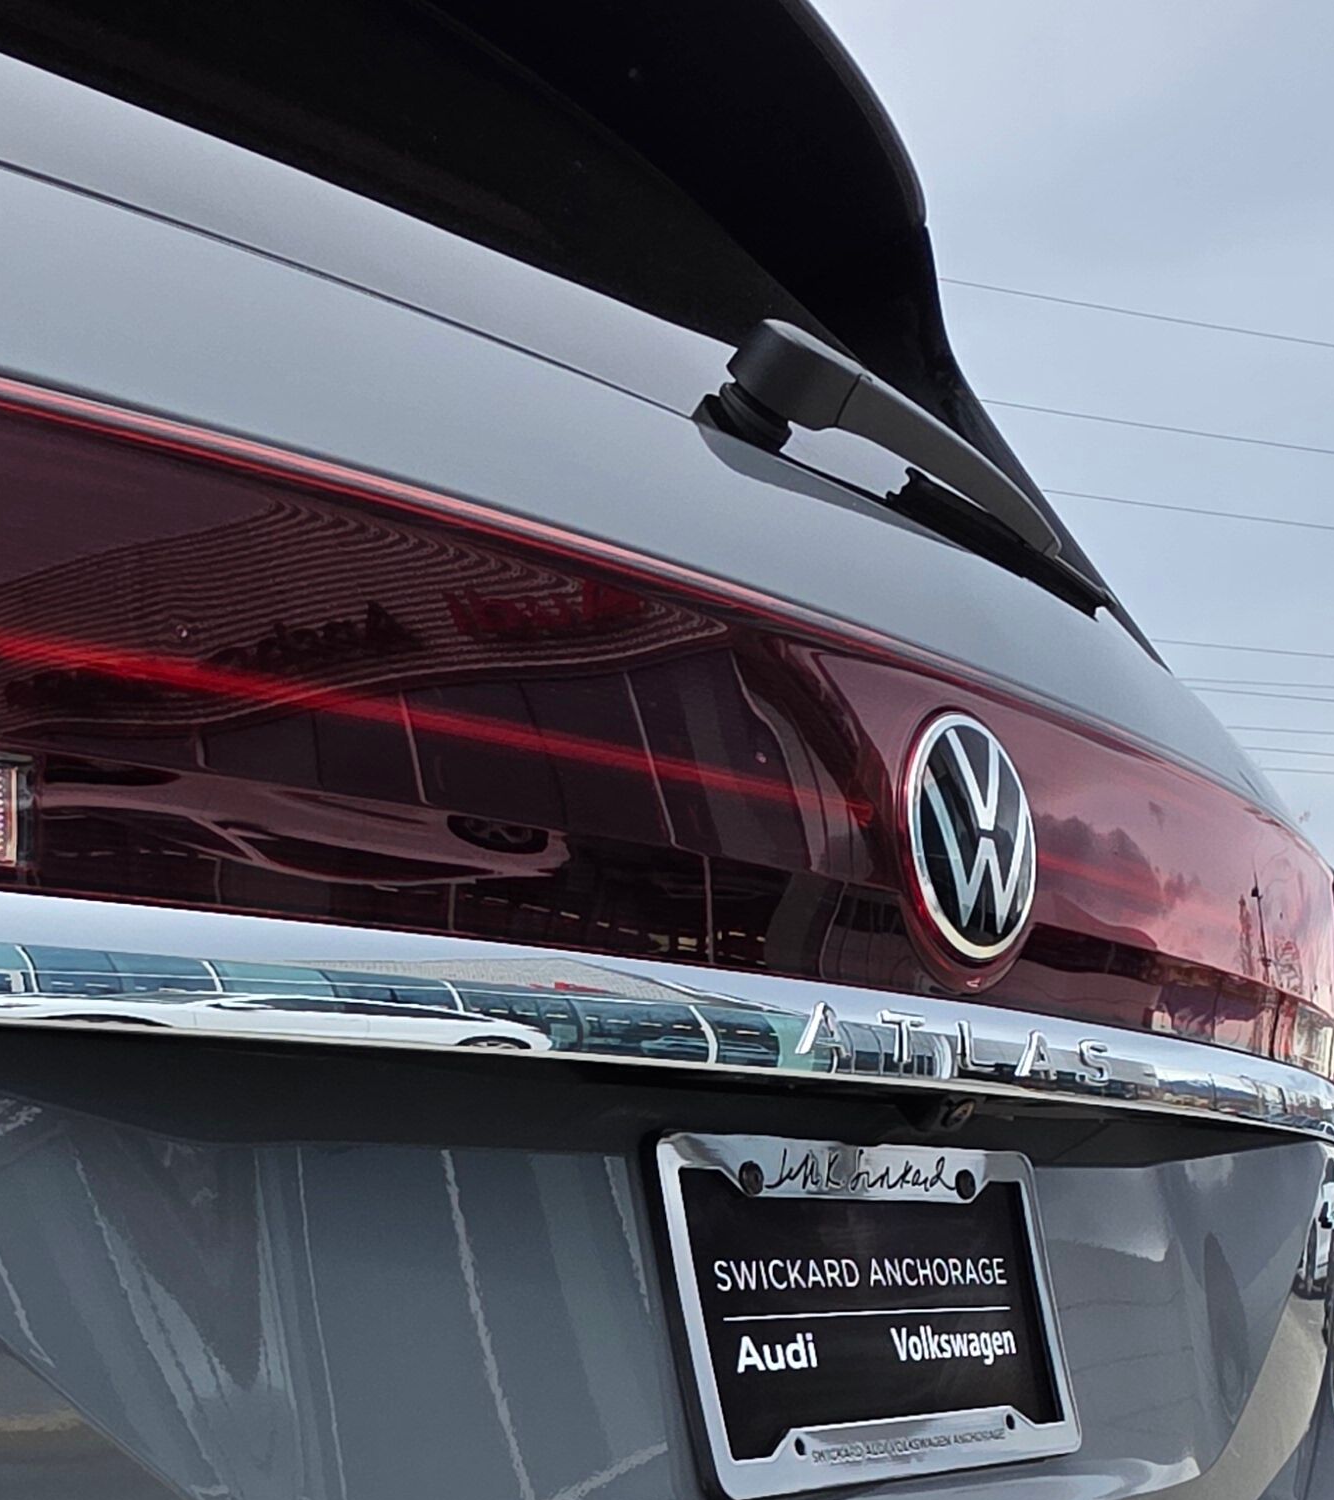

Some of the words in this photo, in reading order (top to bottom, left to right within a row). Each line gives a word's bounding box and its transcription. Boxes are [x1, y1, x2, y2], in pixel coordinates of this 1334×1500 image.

[794, 1000, 1113, 1083] ATLAS
[713, 1258, 860, 1292] SWICKARD
[869, 1257, 1008, 1288] ANCHORAGE
[736, 1332, 819, 1373] Audi
[890, 1325, 1017, 1365] Volkswagen
